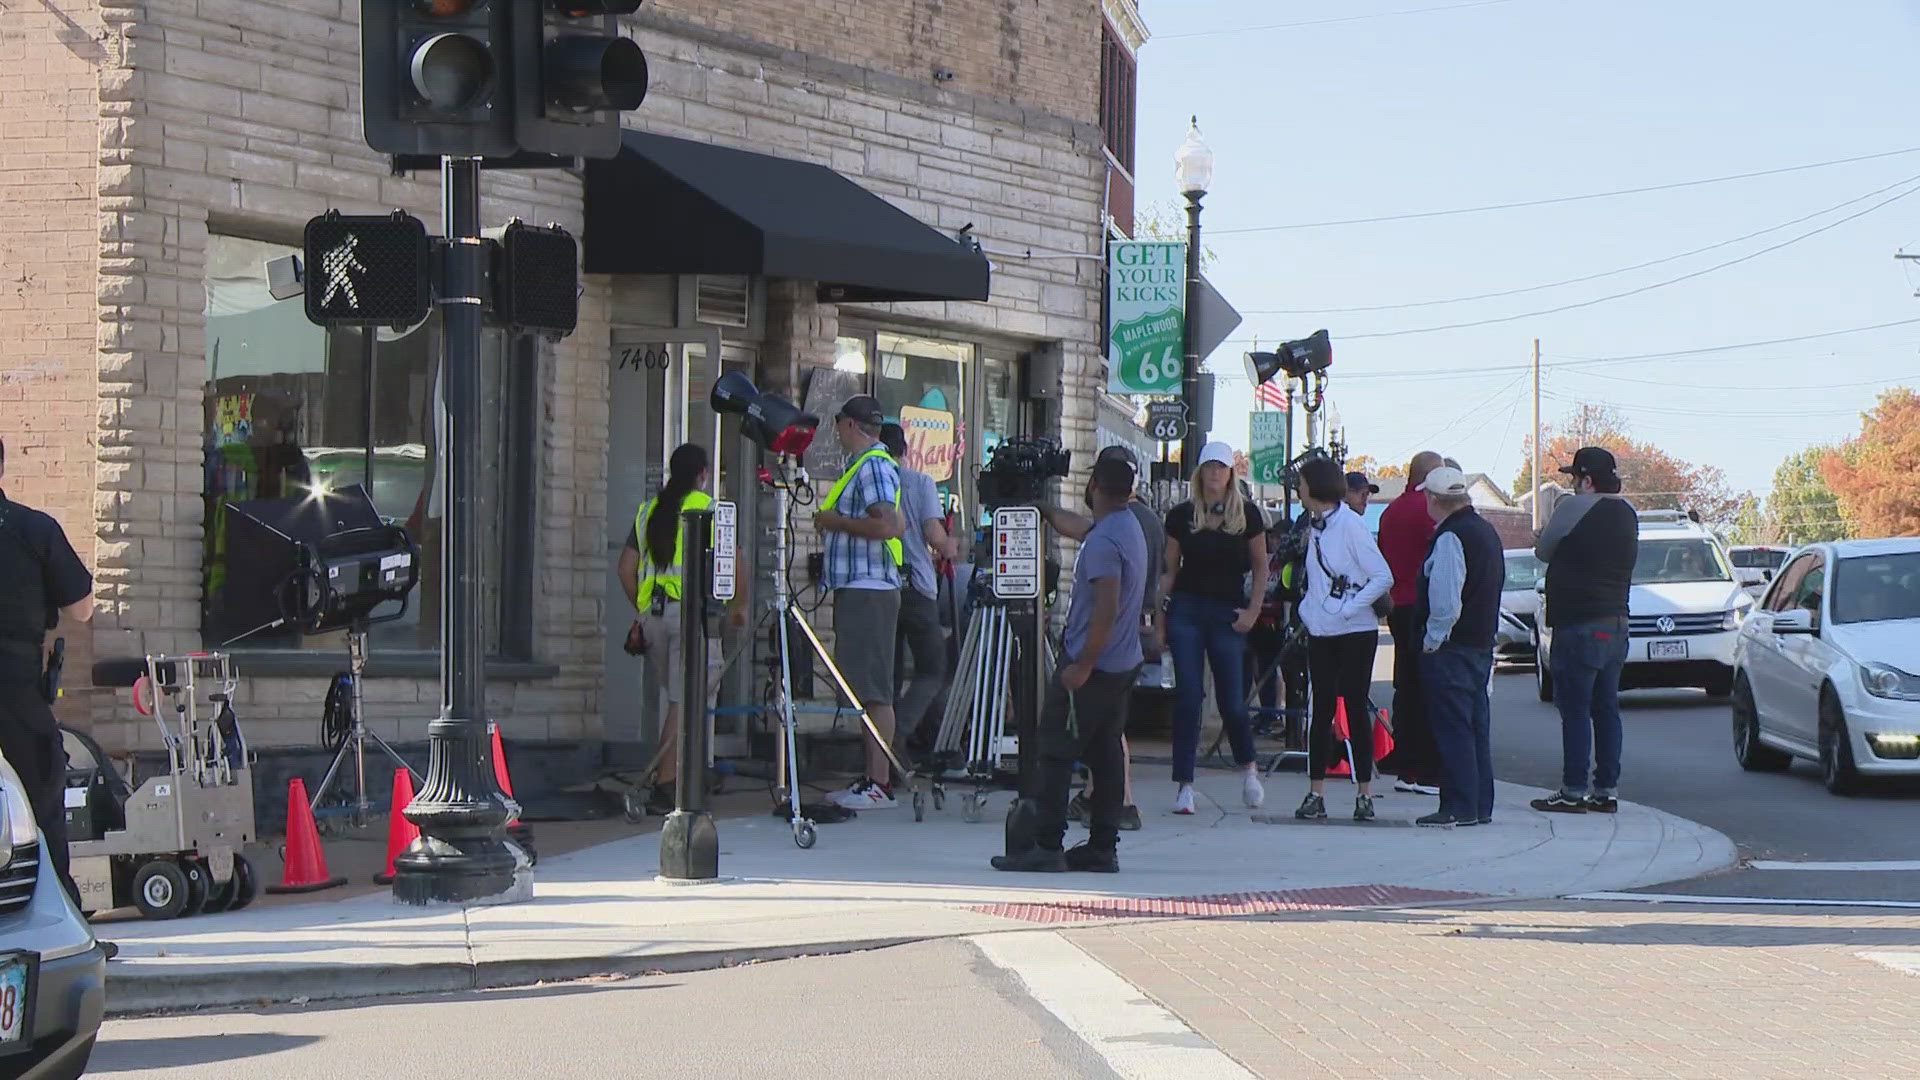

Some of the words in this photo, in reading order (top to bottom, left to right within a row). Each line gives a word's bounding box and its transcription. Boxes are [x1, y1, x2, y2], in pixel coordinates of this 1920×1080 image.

[1116, 243, 1179, 266] GET
[1117, 268, 1176, 284] YOUR
[1117, 287, 1178, 301] KICKS
[1122, 316, 1179, 343] MAPLEWOOD
[618, 348, 670, 372] 7400
[1138, 345, 1182, 385] 66
[1154, 419, 1178, 437] 66
[1253, 413, 1282, 424] GET
[1253, 423, 1284, 432] YOUR
[0, 985, 16, 1031] 8
